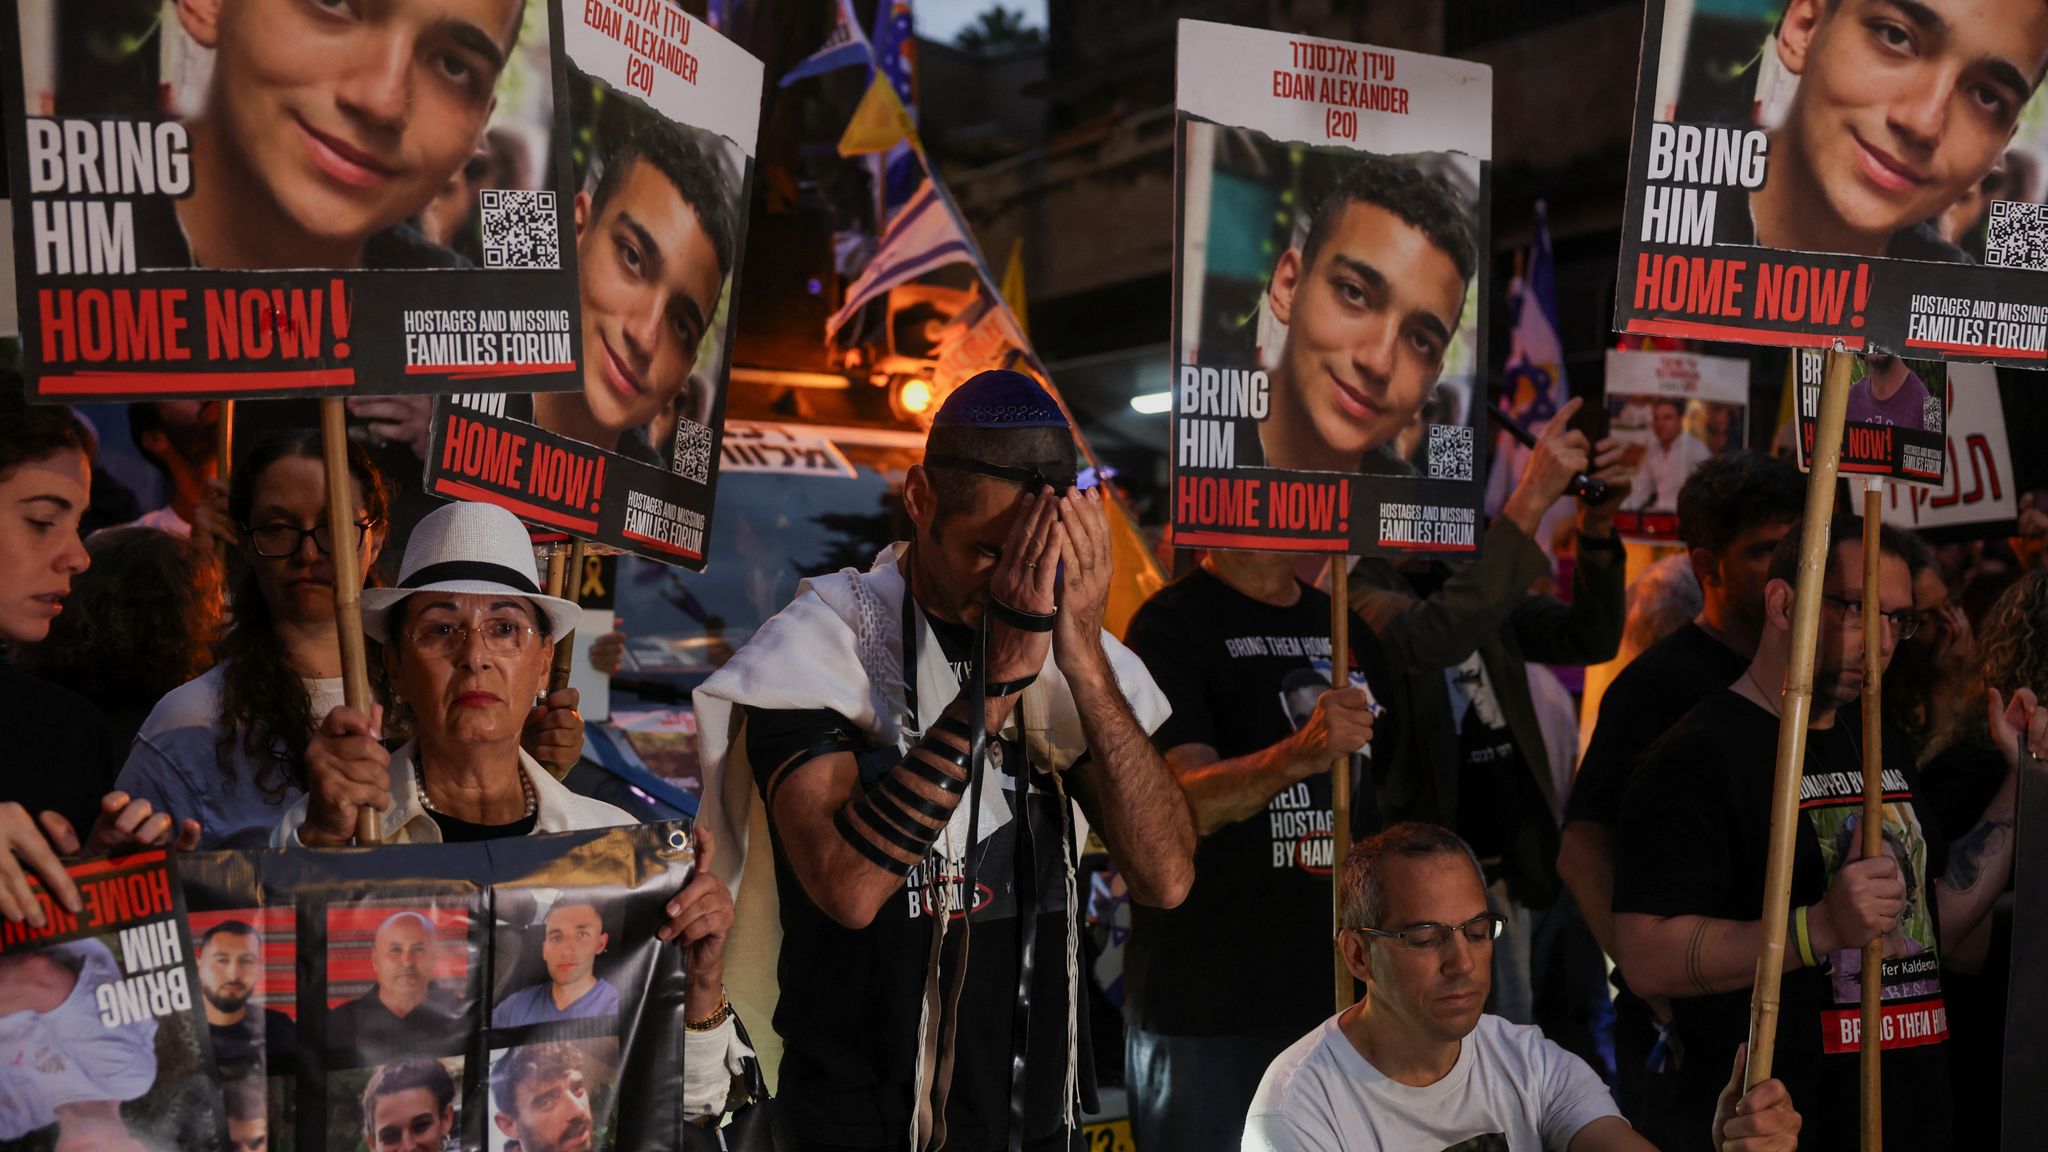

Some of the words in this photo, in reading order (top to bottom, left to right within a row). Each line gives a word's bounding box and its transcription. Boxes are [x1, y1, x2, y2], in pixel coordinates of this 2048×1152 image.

[584, 0, 622, 42] EDAN
[624, 19, 698, 85] ALEXANDER
[1289, 40, 1358, 77] אלכסנדר
[626, 53, 654, 97] (20)
[1362, 51, 1395, 82] עידן
[1273, 70, 1315, 102] EDAN
[1319, 77, 1409, 115] ALEXANDER
[1325, 108, 1358, 142] (20)
[26, 118, 190, 195] BRING
[1647, 122, 1768, 188] BRING
[1640, 185, 1718, 247] HIM
[32, 200, 137, 275] HIM
[1633, 252, 1747, 317] HOME
[1754, 262, 1869, 329] NOW!
[1911, 294, 1970, 318] HOSTAGES
[1971, 300, 1996, 320] AND
[1997, 302, 2048, 325] MISSING
[38, 288, 192, 363] HOME
[204, 279, 351, 361] NOW!
[404, 310, 478, 333] HOSTAGES
[480, 310, 509, 332] AND
[510, 310, 570, 332] MISSING
[1908, 313, 1984, 347] FAMILIES
[1986, 320, 2047, 352] FORUM
[405, 333, 498, 366] FAMILIES
[502, 332, 572, 365] FORUM
[1180, 365, 1269, 419] BRING
[1803, 386, 1820, 418] HI
[442, 415, 527, 489] HOME
[528, 442, 606, 514] NOW!
[1179, 418, 1235, 470] HIM
[1850, 426, 1893, 462] NOW!
[627, 489, 663, 516] HOSTAGES
[662, 502, 677, 521] AND
[677, 506, 705, 530] MISSING
[1178, 476, 1260, 528] HOME
[1268, 479, 1349, 533] NOW!
[1380, 502, 1421, 520] HOSTAGES
[1422, 505, 1439, 521] AND
[1440, 506, 1475, 523] MISSING
[624, 507, 669, 543] FAMILIES
[670, 521, 703, 554] FORUM
[1380, 519, 1432, 543] FAMILIES
[1434, 522, 1475, 546] FORUM
[1225, 636, 1268, 658] BRING
[1265, 636, 1304, 656] THEM
[1800, 772, 1851, 800] DNAPPED
[1270, 810, 1334, 839] HOSTAG
[1272, 841, 1297, 868] BY
[1301, 840, 1334, 867] HAM
[81, 868, 173, 928] HOME
[120, 919, 183, 974] HIM
[1881, 962, 1900, 977] fer
[96, 966, 192, 1029] BRING
[1840, 1015, 1894, 1044] BRG
